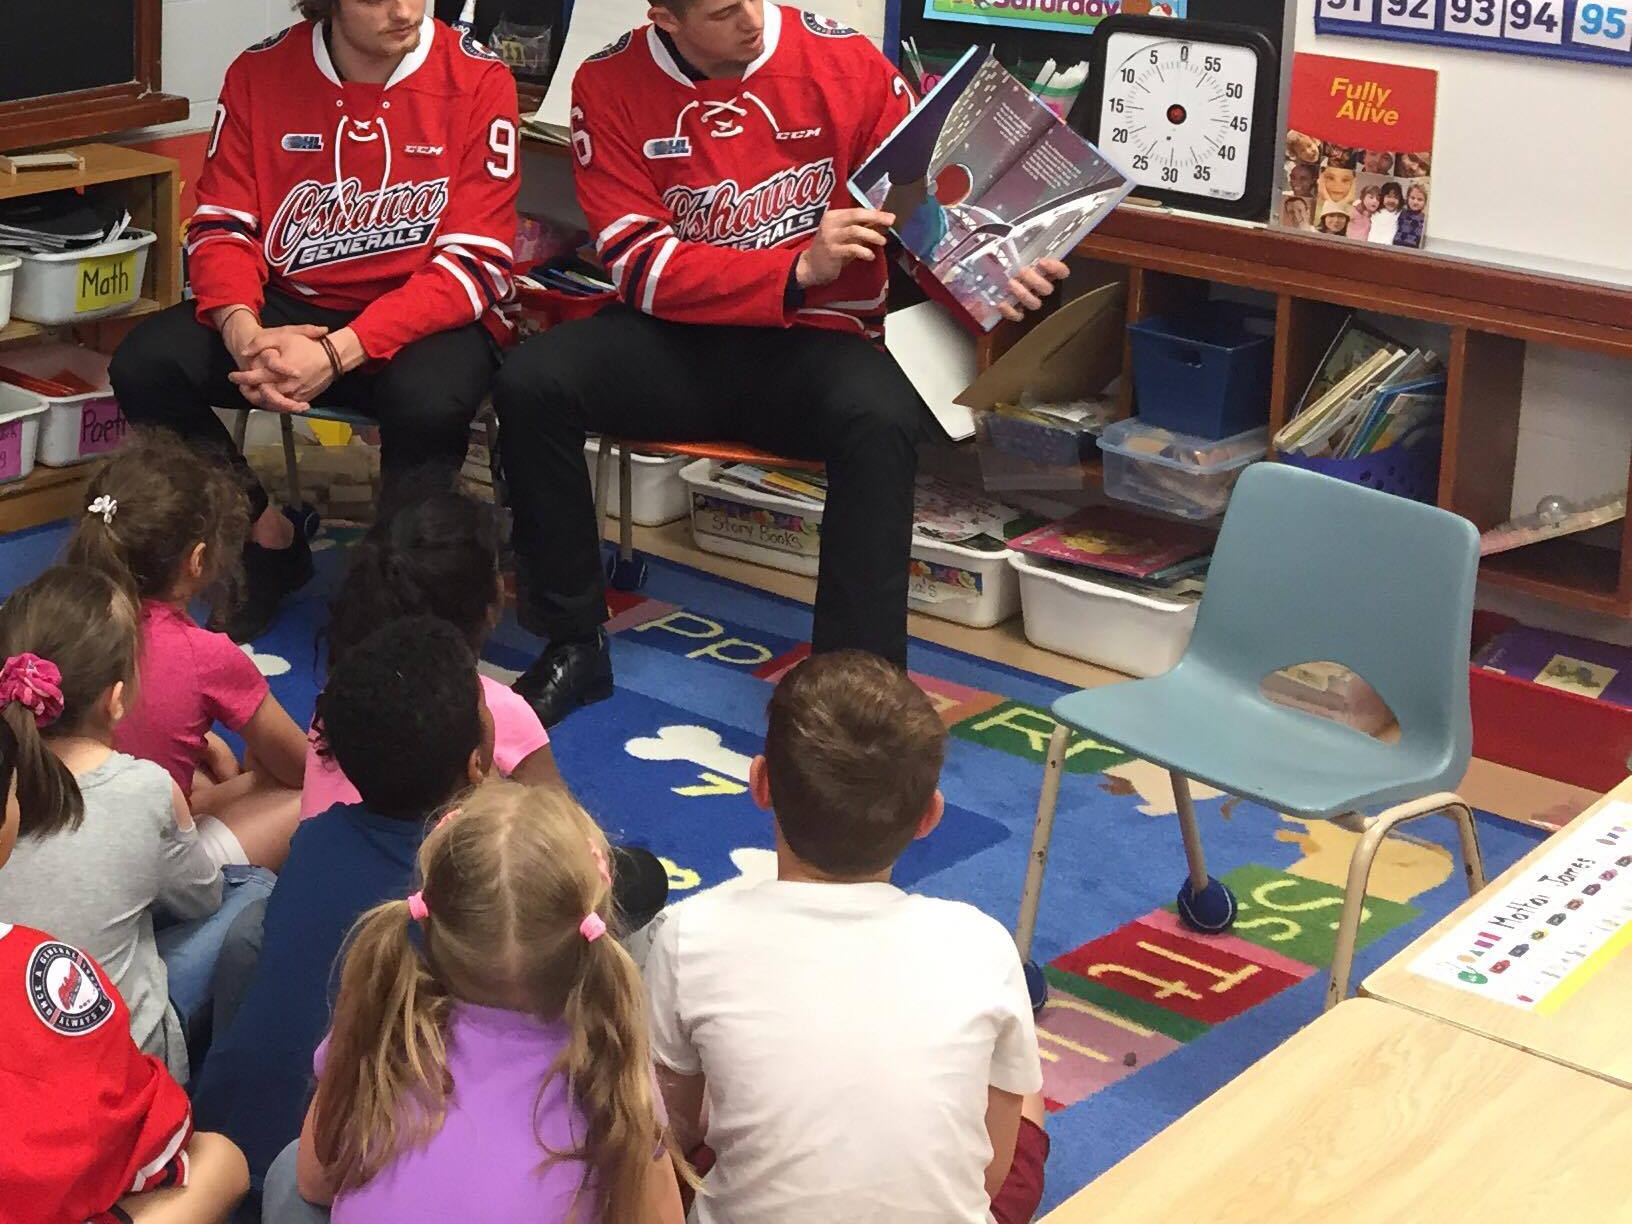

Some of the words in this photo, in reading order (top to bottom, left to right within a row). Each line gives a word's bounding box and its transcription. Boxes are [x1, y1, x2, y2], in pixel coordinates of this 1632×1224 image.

[1205, 57, 1221, 73] 55
[1330, 77, 1391, 104] Fully
[1109, 98, 1124, 113] 15
[1336, 100, 1399, 126] Alive
[1230, 116, 1248, 132] 45
[405, 144, 444, 155] CCM
[487, 118, 516, 179] 9
[265, 177, 448, 265] Oshawa
[298, 226, 426, 265] GENERALS
[82, 268, 129, 297] Math
[712, 516, 752, 537] Story
[760, 523, 802, 548] Books
[59, 1013, 97, 1026] ALWAYS
